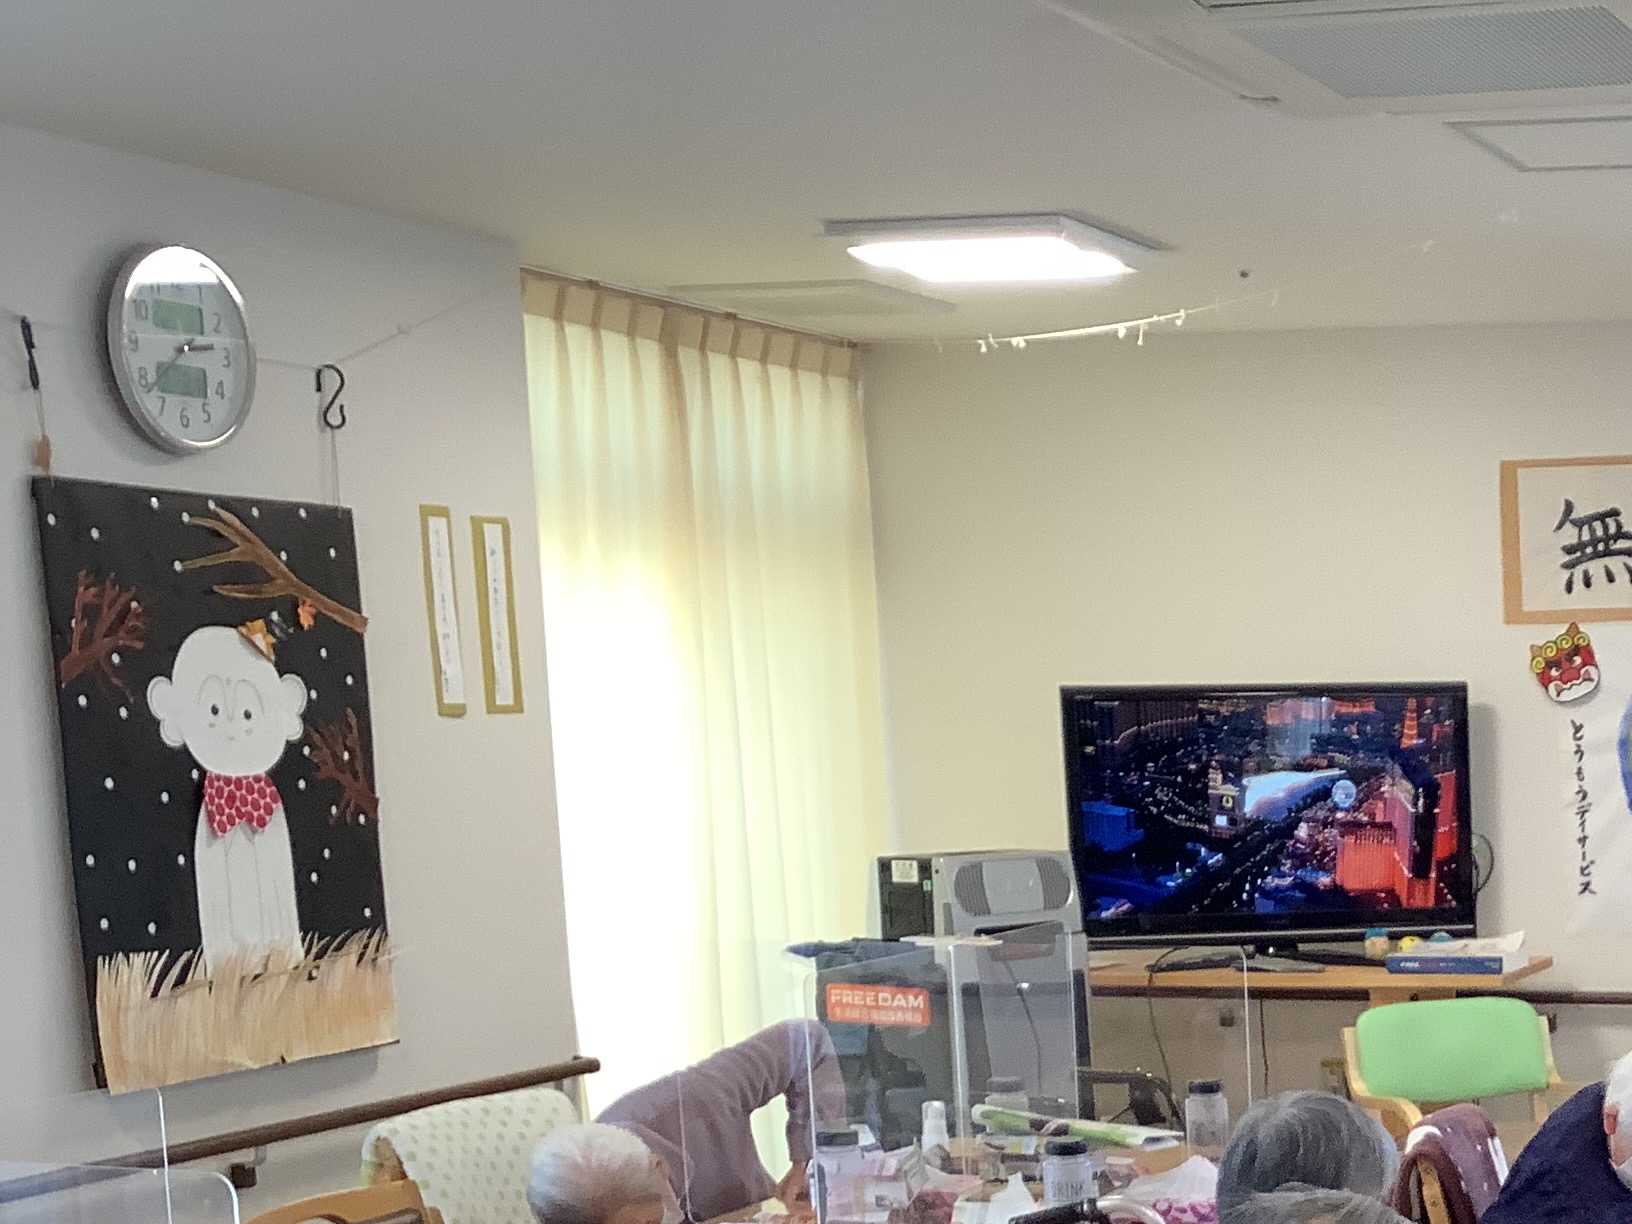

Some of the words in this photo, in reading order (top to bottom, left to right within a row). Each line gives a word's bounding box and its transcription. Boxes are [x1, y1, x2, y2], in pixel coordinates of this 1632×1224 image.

[132, 299, 148, 321] 10
[213, 312, 222, 333] 2
[127, 330, 139, 353] 9
[222, 347, 231, 368] 3
[137, 366, 148, 388] 8
[214, 379, 225, 400] 4
[156, 396, 166, 416] 7
[201, 401, 211, 423] 5
[179, 407, 190, 428] 6
[830, 988, 924, 1009] FREEDAM
